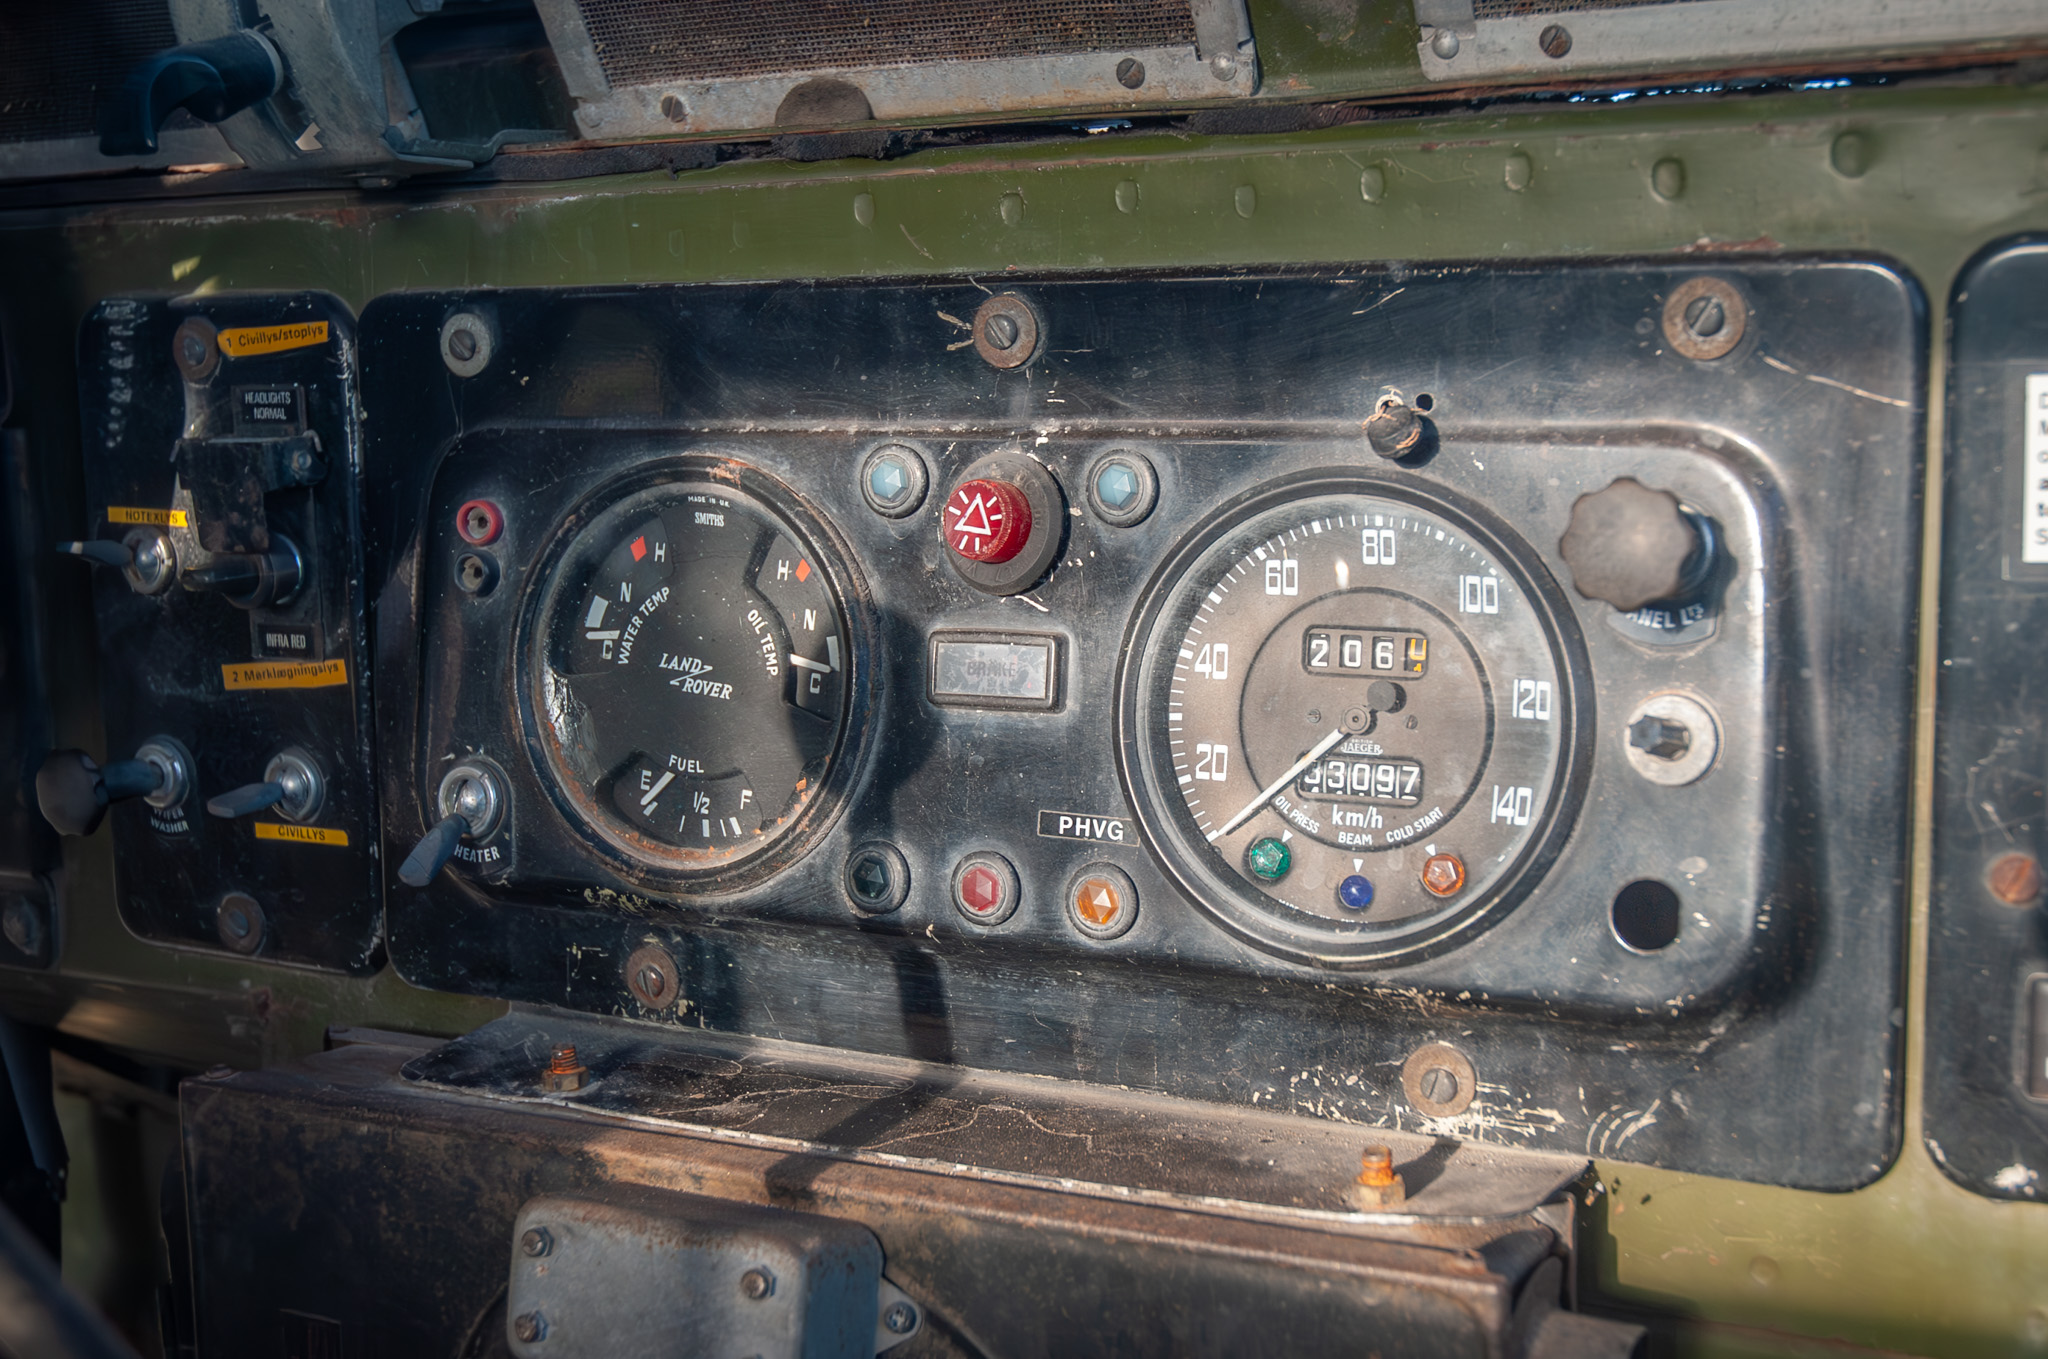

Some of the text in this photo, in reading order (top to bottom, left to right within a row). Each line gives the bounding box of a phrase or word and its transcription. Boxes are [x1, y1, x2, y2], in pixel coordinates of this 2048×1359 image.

[238, 325, 324, 347] Civillys/stoplys
[245, 391, 291, 404] HEADLIGHTS
[254, 407, 287, 420] NORMAL
[694, 511, 725, 527] SMITHS
[655, 542, 666, 562] H
[1361, 529, 1396, 566] 80
[777, 560, 790, 580] H
[1265, 559, 1298, 596] 60
[620, 582, 632, 602] N
[1459, 575, 1499, 614] 100
[618, 587, 671, 665] WATER TEMP
[803, 608, 817, 630] N
[266, 632, 307, 649] INFRA RED
[747, 609, 779, 677] OIL TEMP
[659, 653, 702, 673] LAND
[1194, 643, 1229, 680] 40
[232, 671, 240, 682] 2
[810, 673, 821, 694] C
[682, 678, 733, 699] ROVER
[1512, 679, 1552, 720] 120
[1340, 742, 1384, 755] JAEGER
[669, 754, 704, 773] FUEL
[1195, 743, 1229, 781] 20
[640, 770, 652, 791] E
[693, 791, 710, 815] 1/2
[739, 789, 753, 810] F
[1491, 785, 1534, 826] 140
[150, 816, 190, 833] WASHER
[1275, 795, 1320, 834] OIL PRESS
[1332, 804, 1383, 829] km/h
[1385, 806, 1445, 843] COLD START
[278, 826, 326, 841] CIVILLYS
[1058, 814, 1125, 842] PHVG
[1338, 831, 1373, 845] BEAM
[454, 843, 501, 863] HEATER
